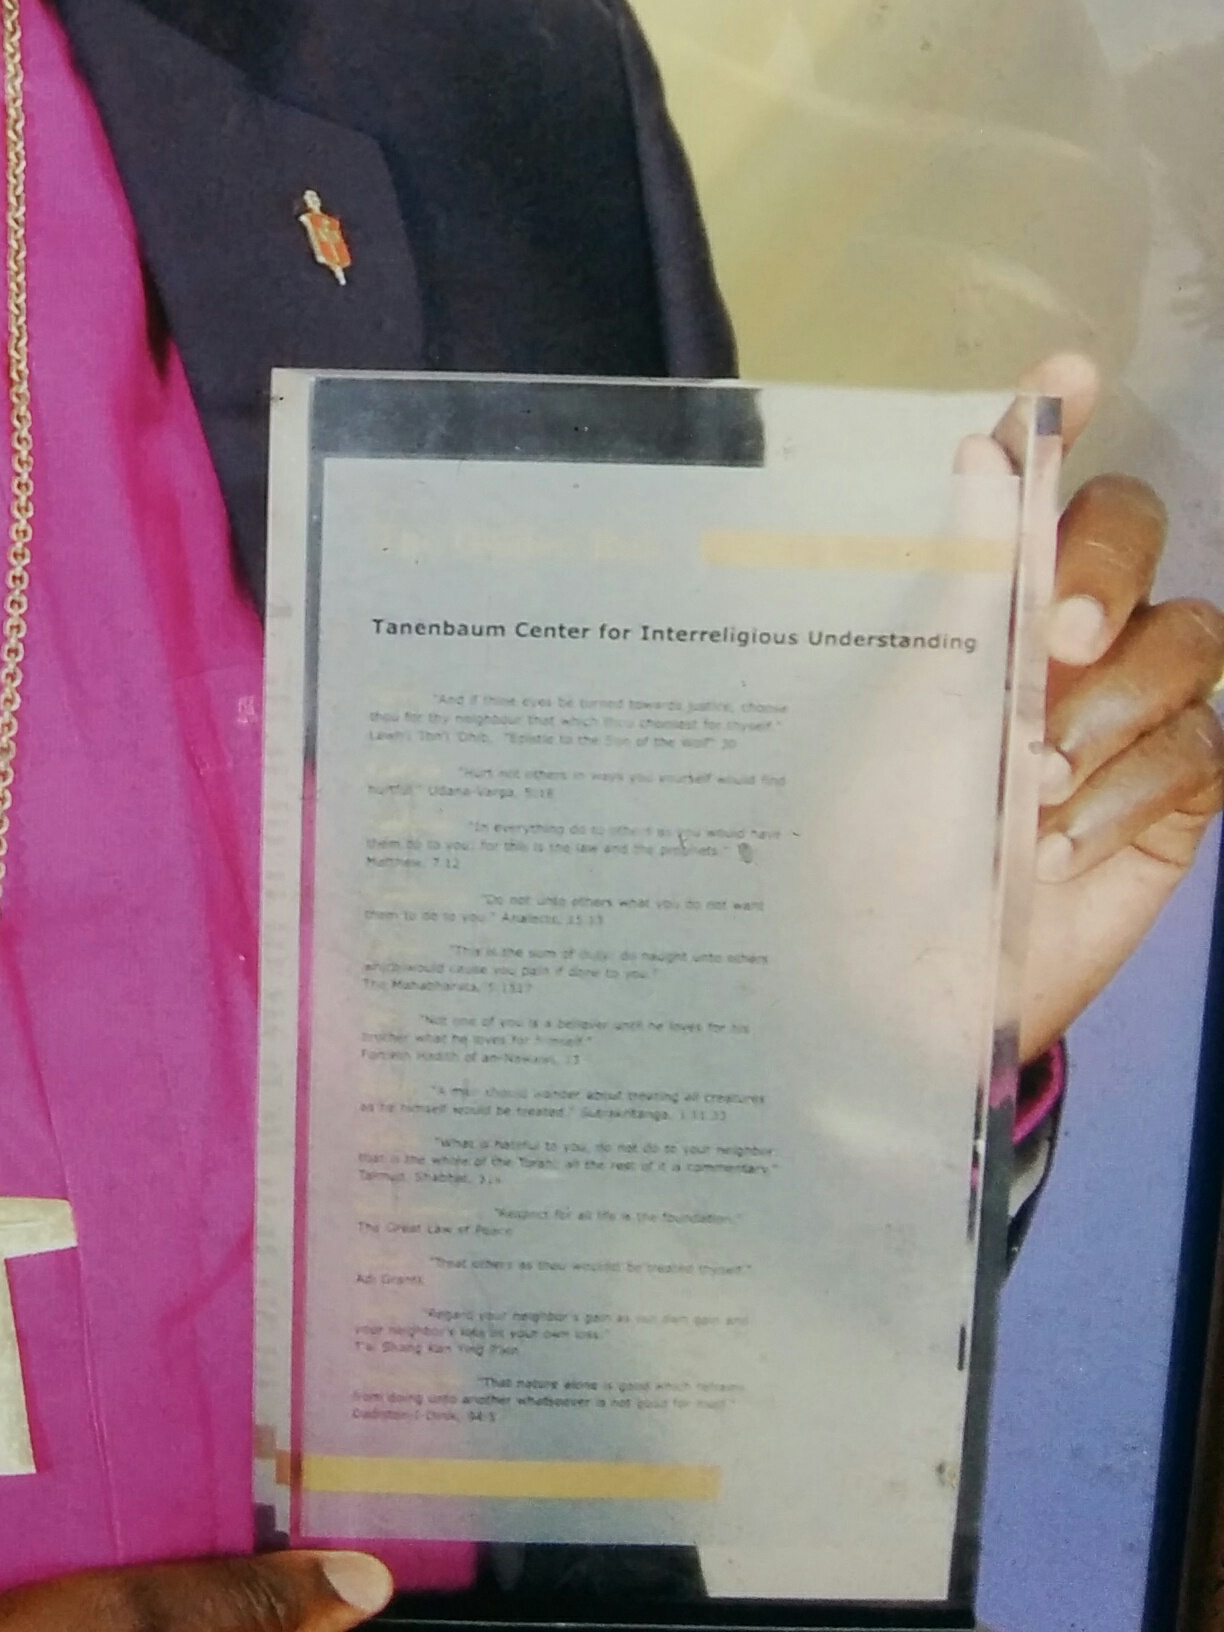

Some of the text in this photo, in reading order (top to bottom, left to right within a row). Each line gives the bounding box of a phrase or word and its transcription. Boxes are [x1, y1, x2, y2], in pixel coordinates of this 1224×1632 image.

[372, 618, 977, 654] Tanenbaum Center for Interreligious Understanding
